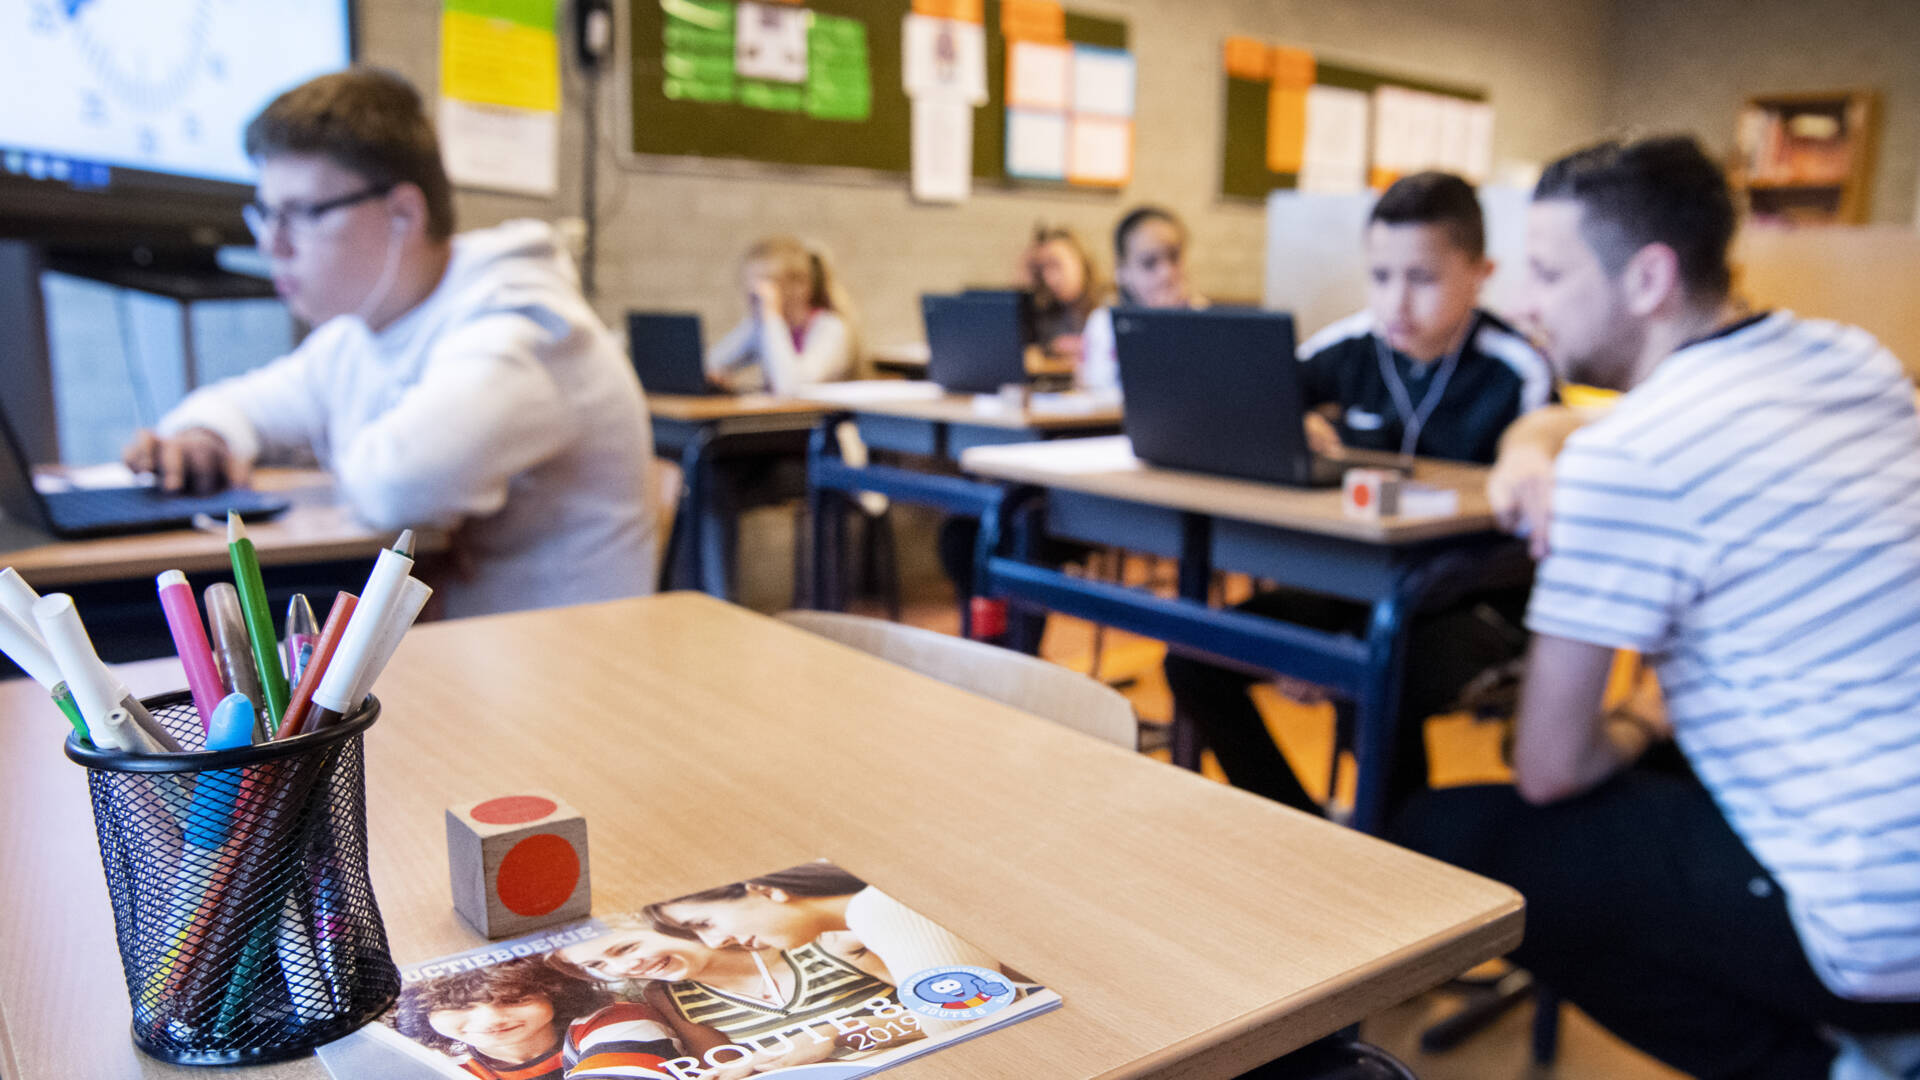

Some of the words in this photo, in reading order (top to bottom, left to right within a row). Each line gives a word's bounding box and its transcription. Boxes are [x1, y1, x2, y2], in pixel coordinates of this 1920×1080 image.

[402, 926, 599, 983] UCTIEBOEKJE
[847, 1015, 922, 1051] 2019
[917, 1004, 973, 1018] ROUTE
[657, 1007, 869, 1080] ROUTE
[864, 996, 905, 1019] 8
